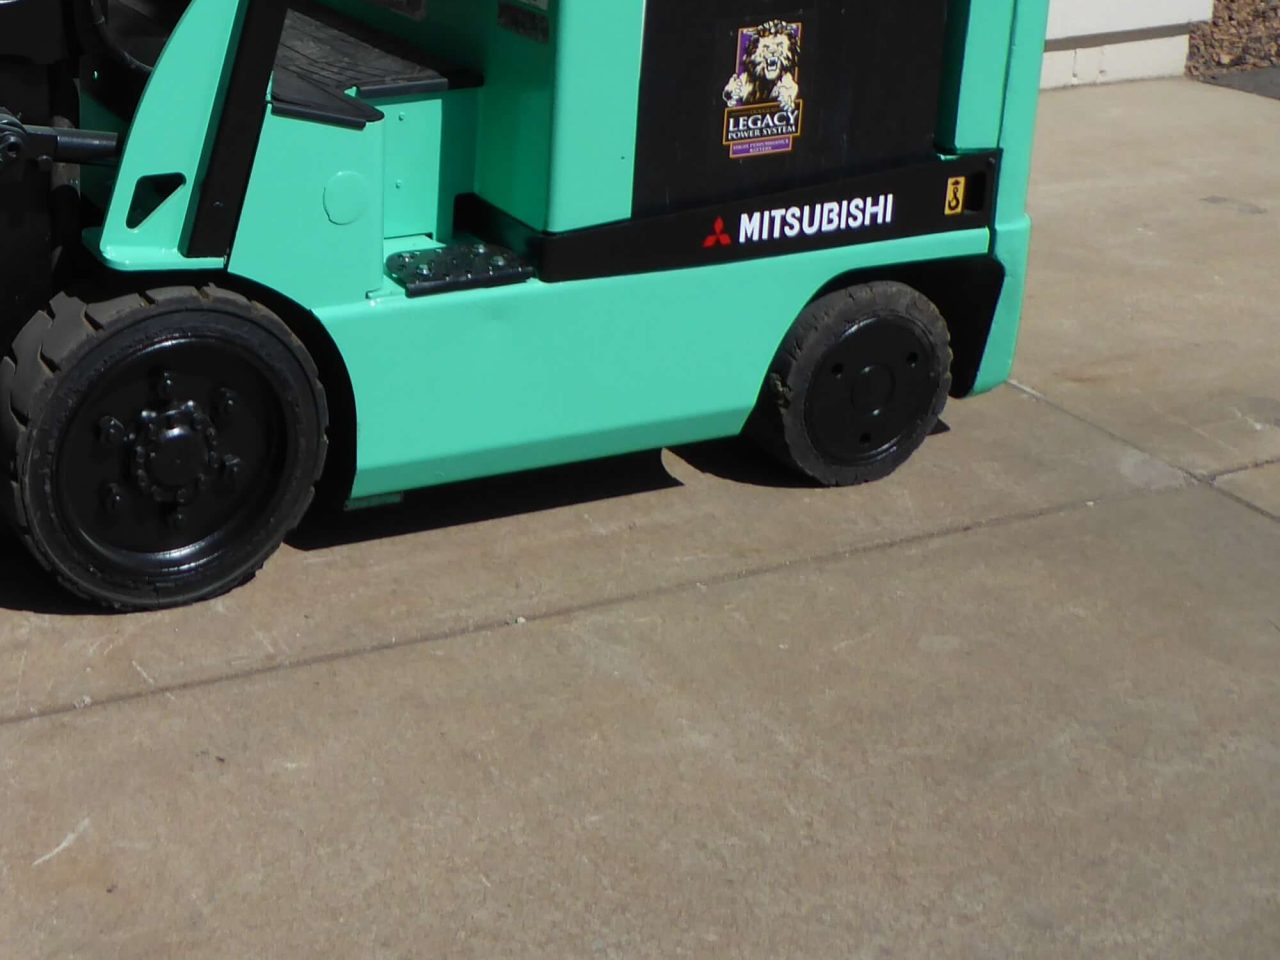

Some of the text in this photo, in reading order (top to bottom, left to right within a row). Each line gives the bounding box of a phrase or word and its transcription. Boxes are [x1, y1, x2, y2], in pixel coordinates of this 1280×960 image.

[729, 110, 798, 132] LEGACY
[728, 125, 796, 140] POWER SYSTEM
[739, 194, 893, 243] MITSUBISHI
